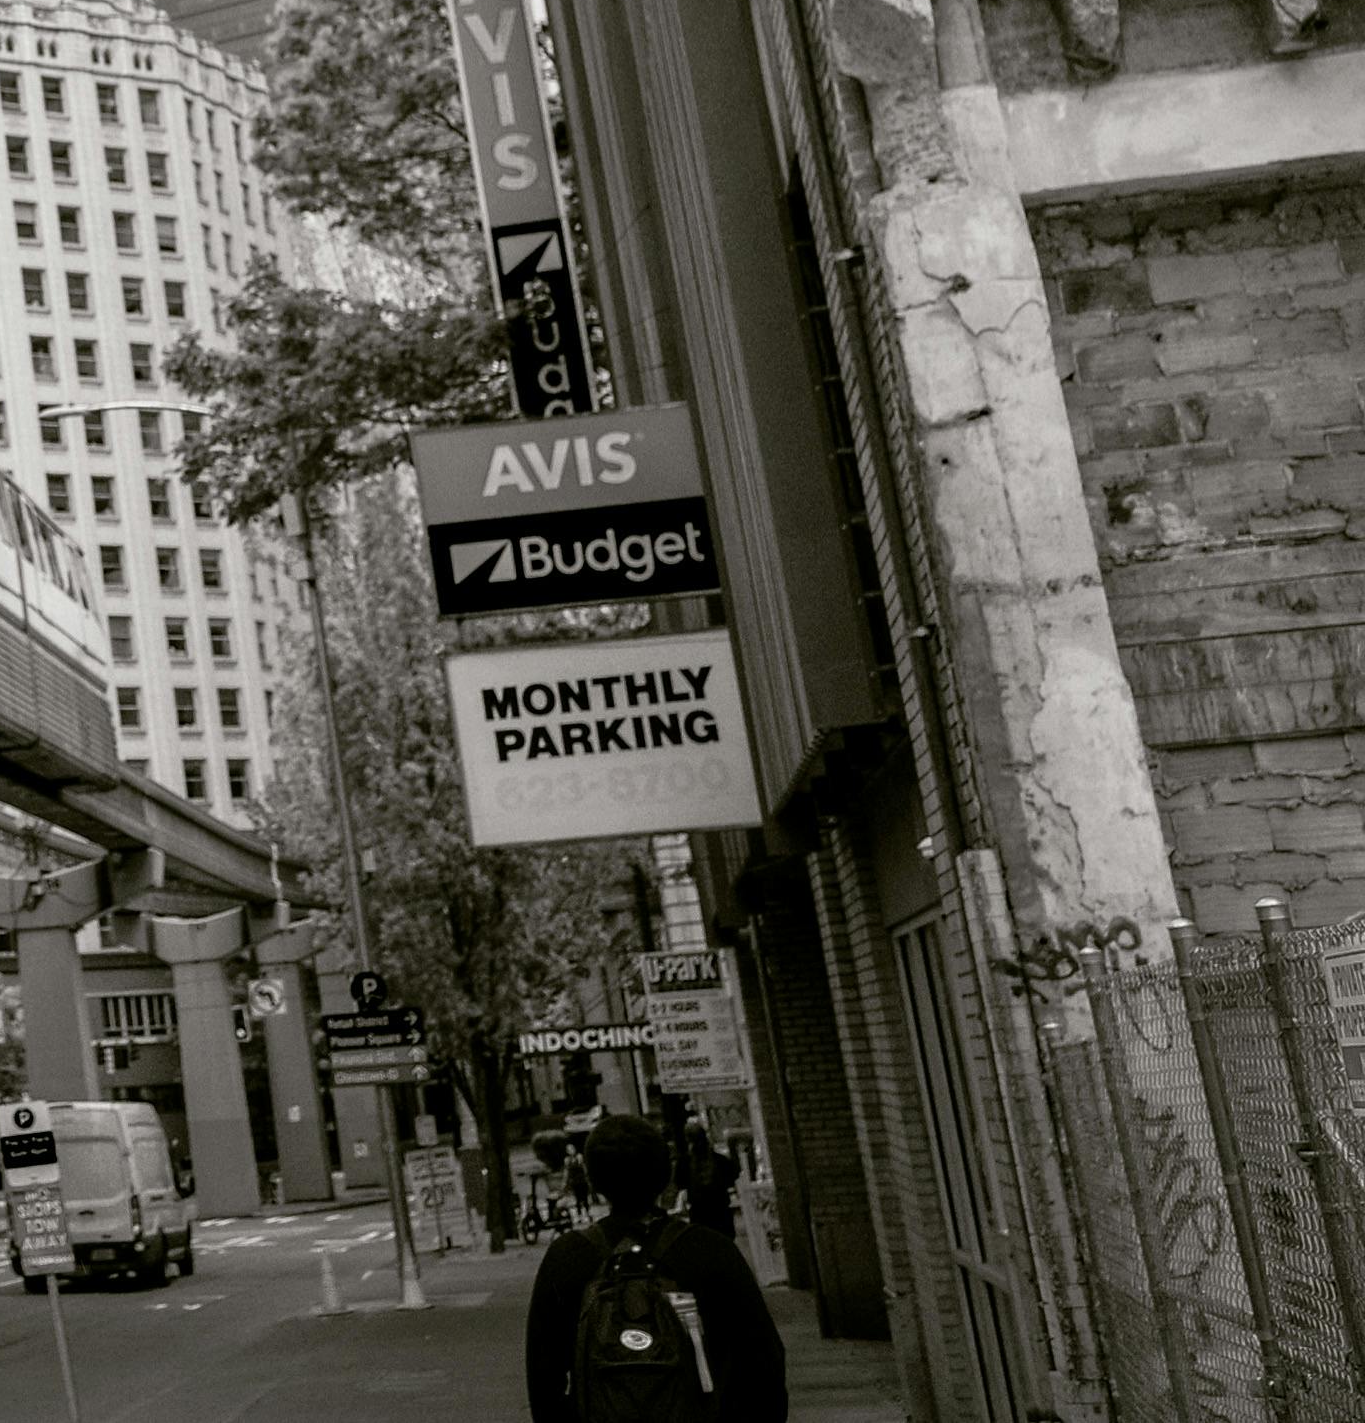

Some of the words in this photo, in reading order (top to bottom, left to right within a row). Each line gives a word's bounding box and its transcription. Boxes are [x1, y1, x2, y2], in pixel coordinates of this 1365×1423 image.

[482, 431, 637, 497] AVIS
[520, 522, 705, 582] Budget
[482, 665, 712, 721] MONTHLY
[495, 709, 720, 762] PARKING
[519, 1025, 655, 1054] INDOCHINO
